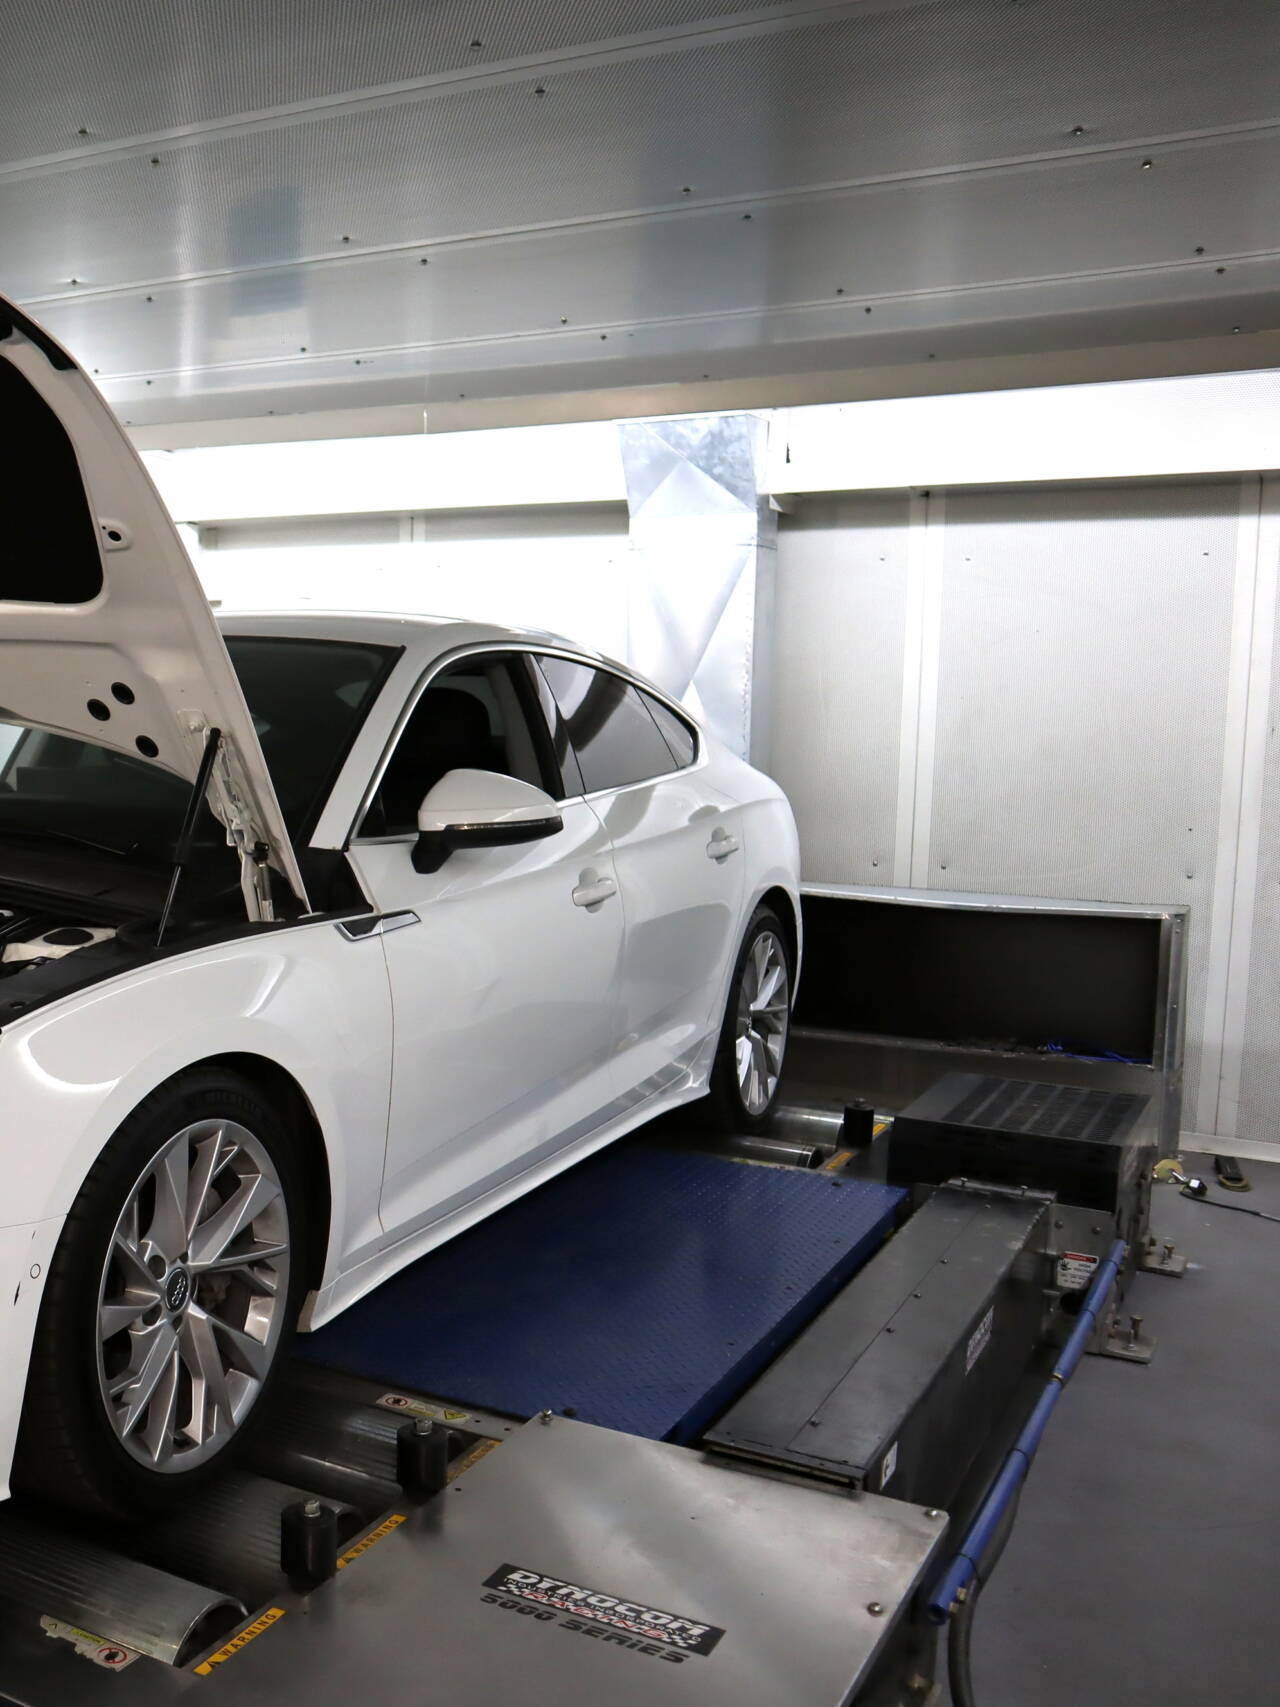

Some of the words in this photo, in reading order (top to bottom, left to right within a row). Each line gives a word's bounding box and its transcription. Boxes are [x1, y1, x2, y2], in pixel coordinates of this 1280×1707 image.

[351, 1519, 400, 1554] WARNING
[506, 1569, 711, 1637] DYNOCOM
[522, 1590, 668, 1639] RACING
[218, 1613, 277, 1657] WARNING
[480, 1592, 558, 1621] 5000
[558, 1619, 691, 1664] SERIES
